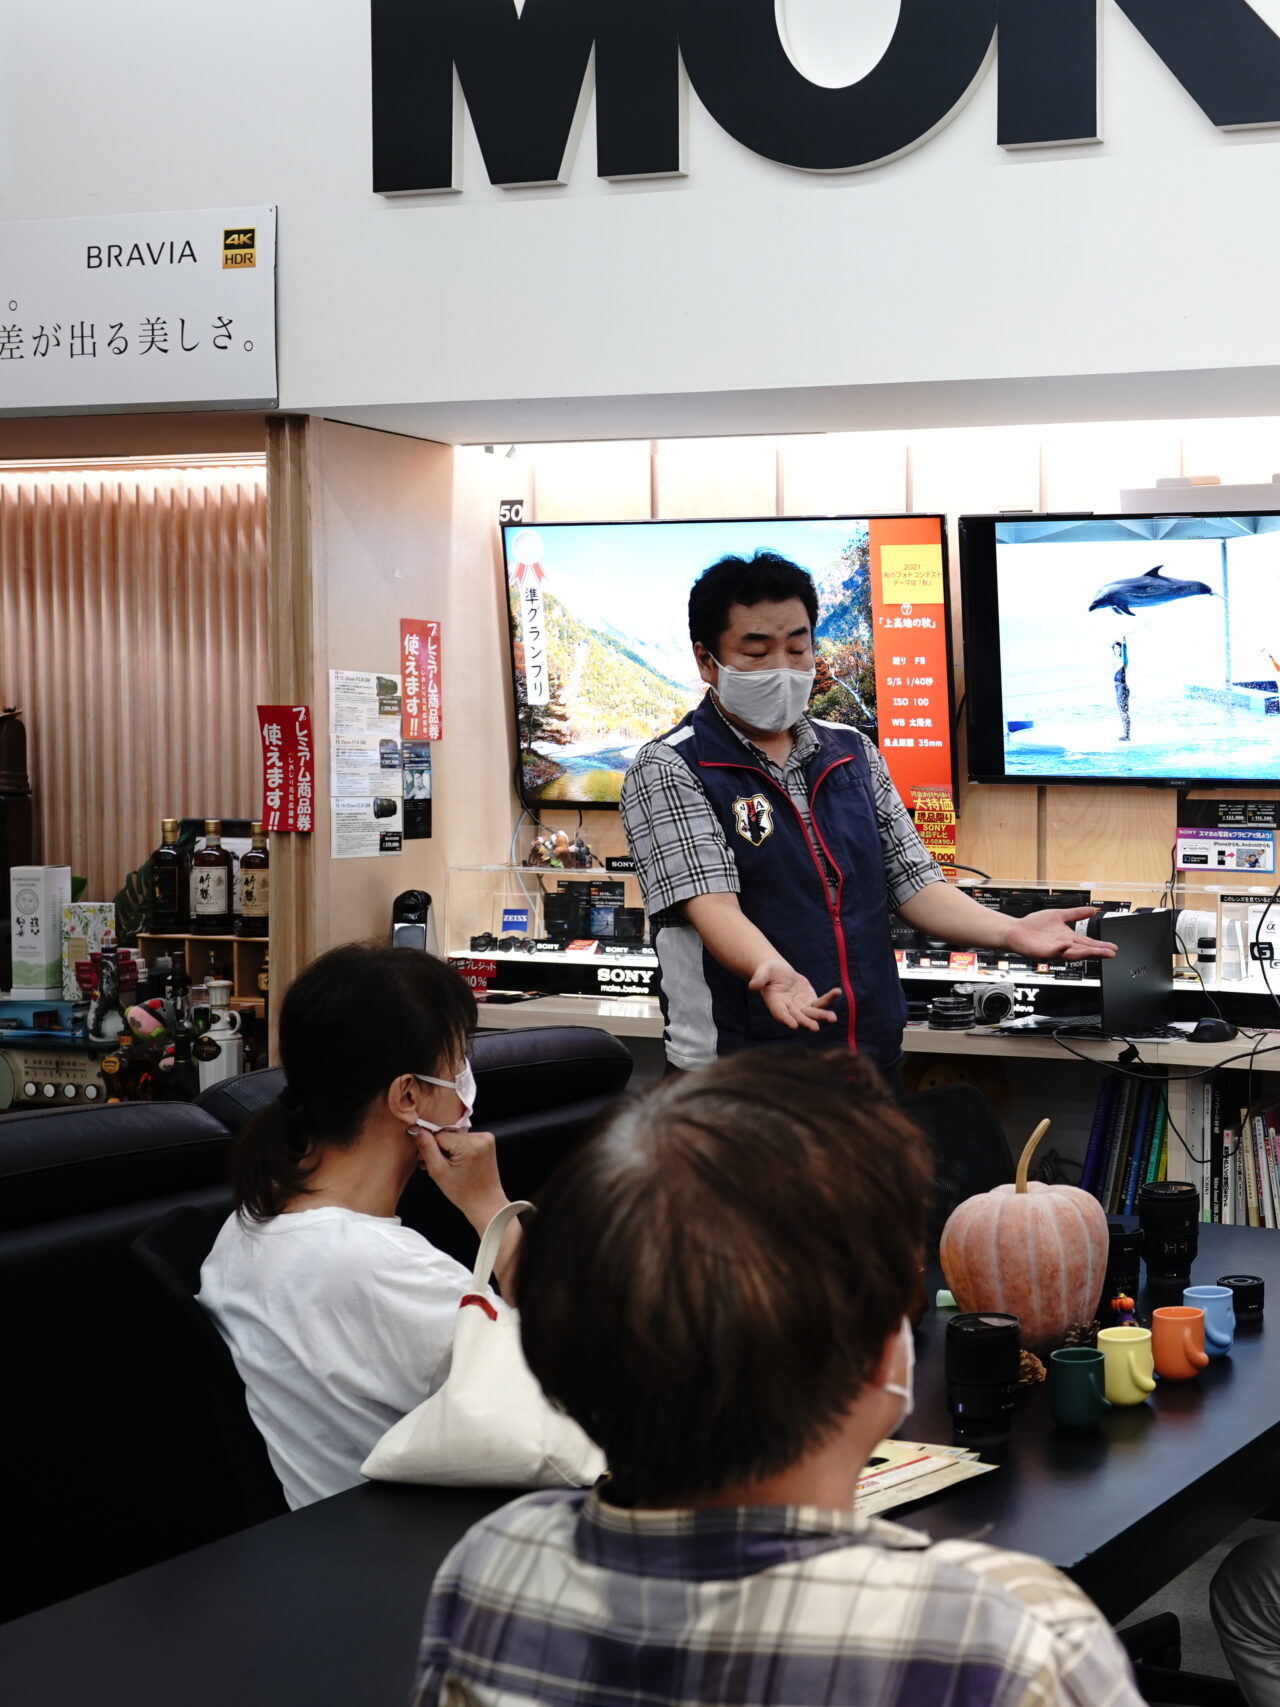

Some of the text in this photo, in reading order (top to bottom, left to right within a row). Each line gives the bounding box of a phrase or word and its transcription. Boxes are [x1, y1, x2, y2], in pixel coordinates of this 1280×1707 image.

[225, 232, 253, 246] 4K
[86, 240, 198, 269] BRAVIA
[225, 252, 254, 265] HDR
[0, 316, 254, 361] 差が出る美しさ。
[499, 504, 524, 522] 50
[524, 588, 545, 697] 準グランプリ
[886, 677, 902, 687] S/S
[893, 698, 929, 706] ISO 100
[891, 719, 905, 727] WB
[918, 739, 943, 747] 35mm
[292, 706, 311, 831] プレミアム商品券
[913, 797, 954, 811] 大特価
[917, 812, 952, 823] 現品限り
[503, 914, 528, 922] ZEISS
[597, 968, 654, 983] SONY
[600, 984, 649, 994] make.believe
[1014, 988, 1039, 1001] NY
